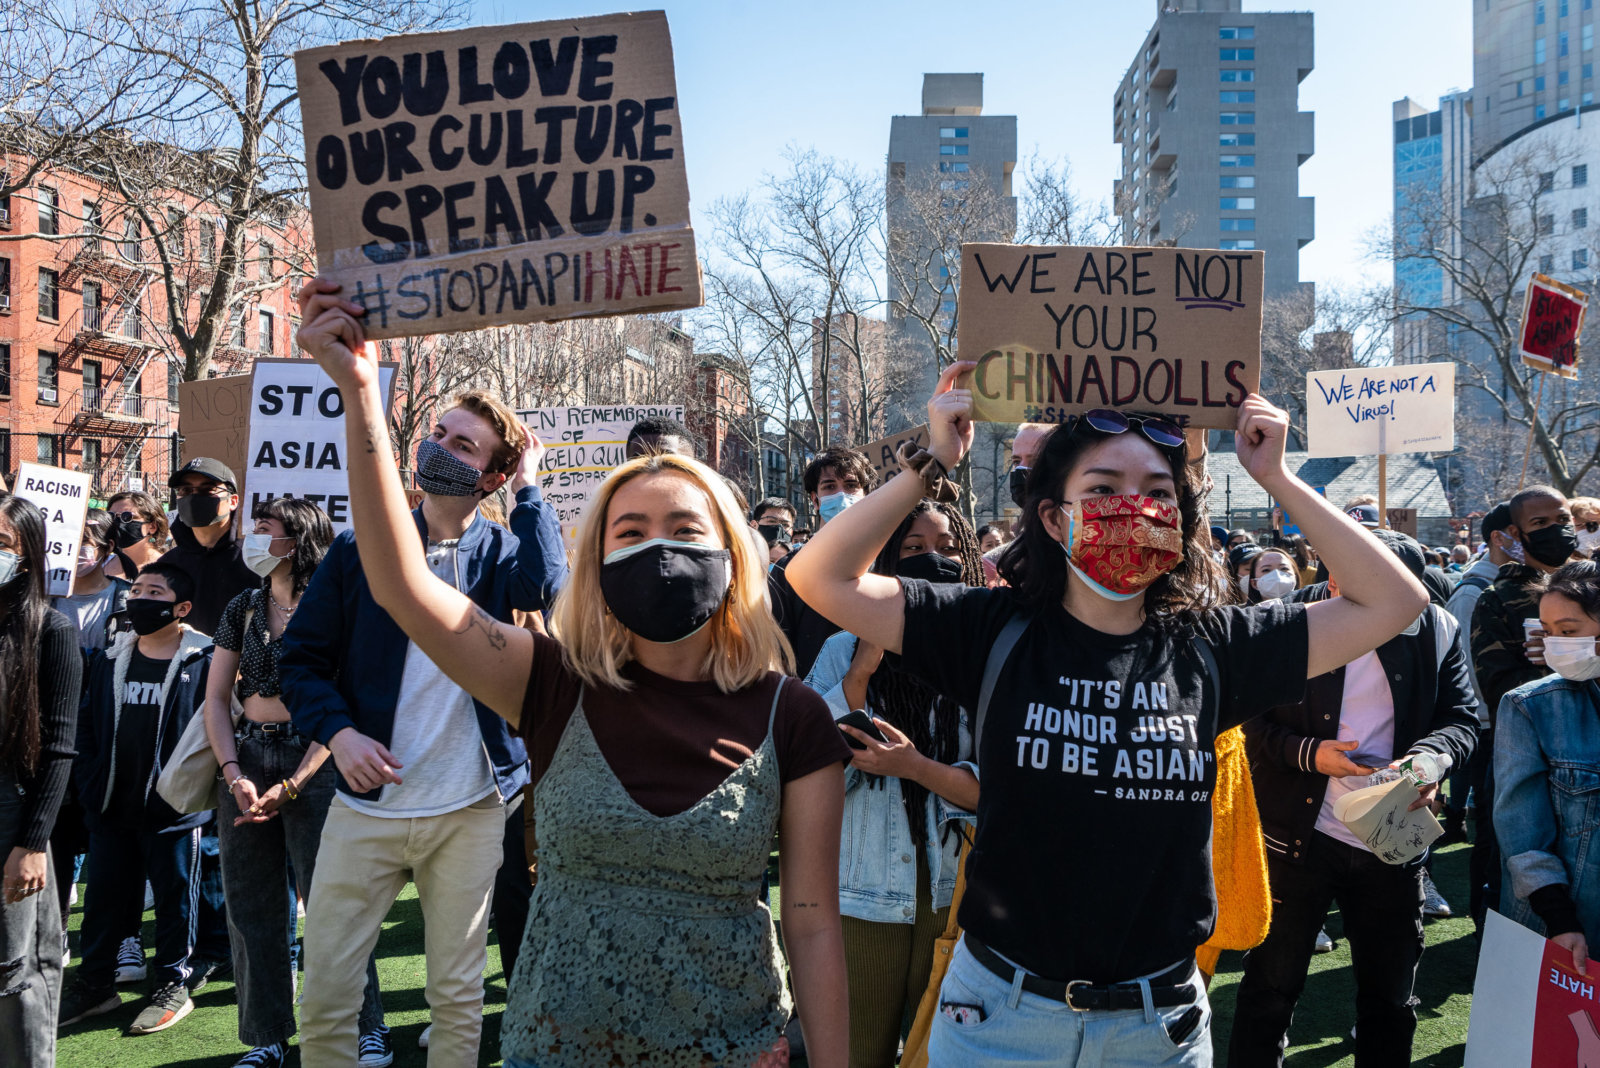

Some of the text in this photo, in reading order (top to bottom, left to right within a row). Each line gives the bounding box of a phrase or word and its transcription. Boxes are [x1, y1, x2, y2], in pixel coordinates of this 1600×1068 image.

[318, 34, 618, 127] YOU LOVE
[316, 96, 675, 190] OUR CULTURE
[361, 165, 658, 265] SPEAK UP.
[974, 251, 1253, 303] WE ARE NOT
[1043, 302, 1158, 352] YOUR
[258, 384, 346, 419] STO
[1314, 375, 1436, 406] WE ARE NOT A
[561, 430, 584, 444] OF
[253, 440, 349, 471] ASIA
[25, 477, 81, 498] RACISM
[52, 509, 65, 523] A
[53, 569, 71, 582] IT!
[1132, 681, 1168, 710] AN
[1024, 702, 1197, 744] HONOR JUST
[1016, 736, 1050, 770] TO
[1061, 741, 1099, 776] BE
[1114, 787, 1185, 801] SANDRA
[1190, 790, 1209, 802] OH
[1549, 967, 1594, 1001] HATE
